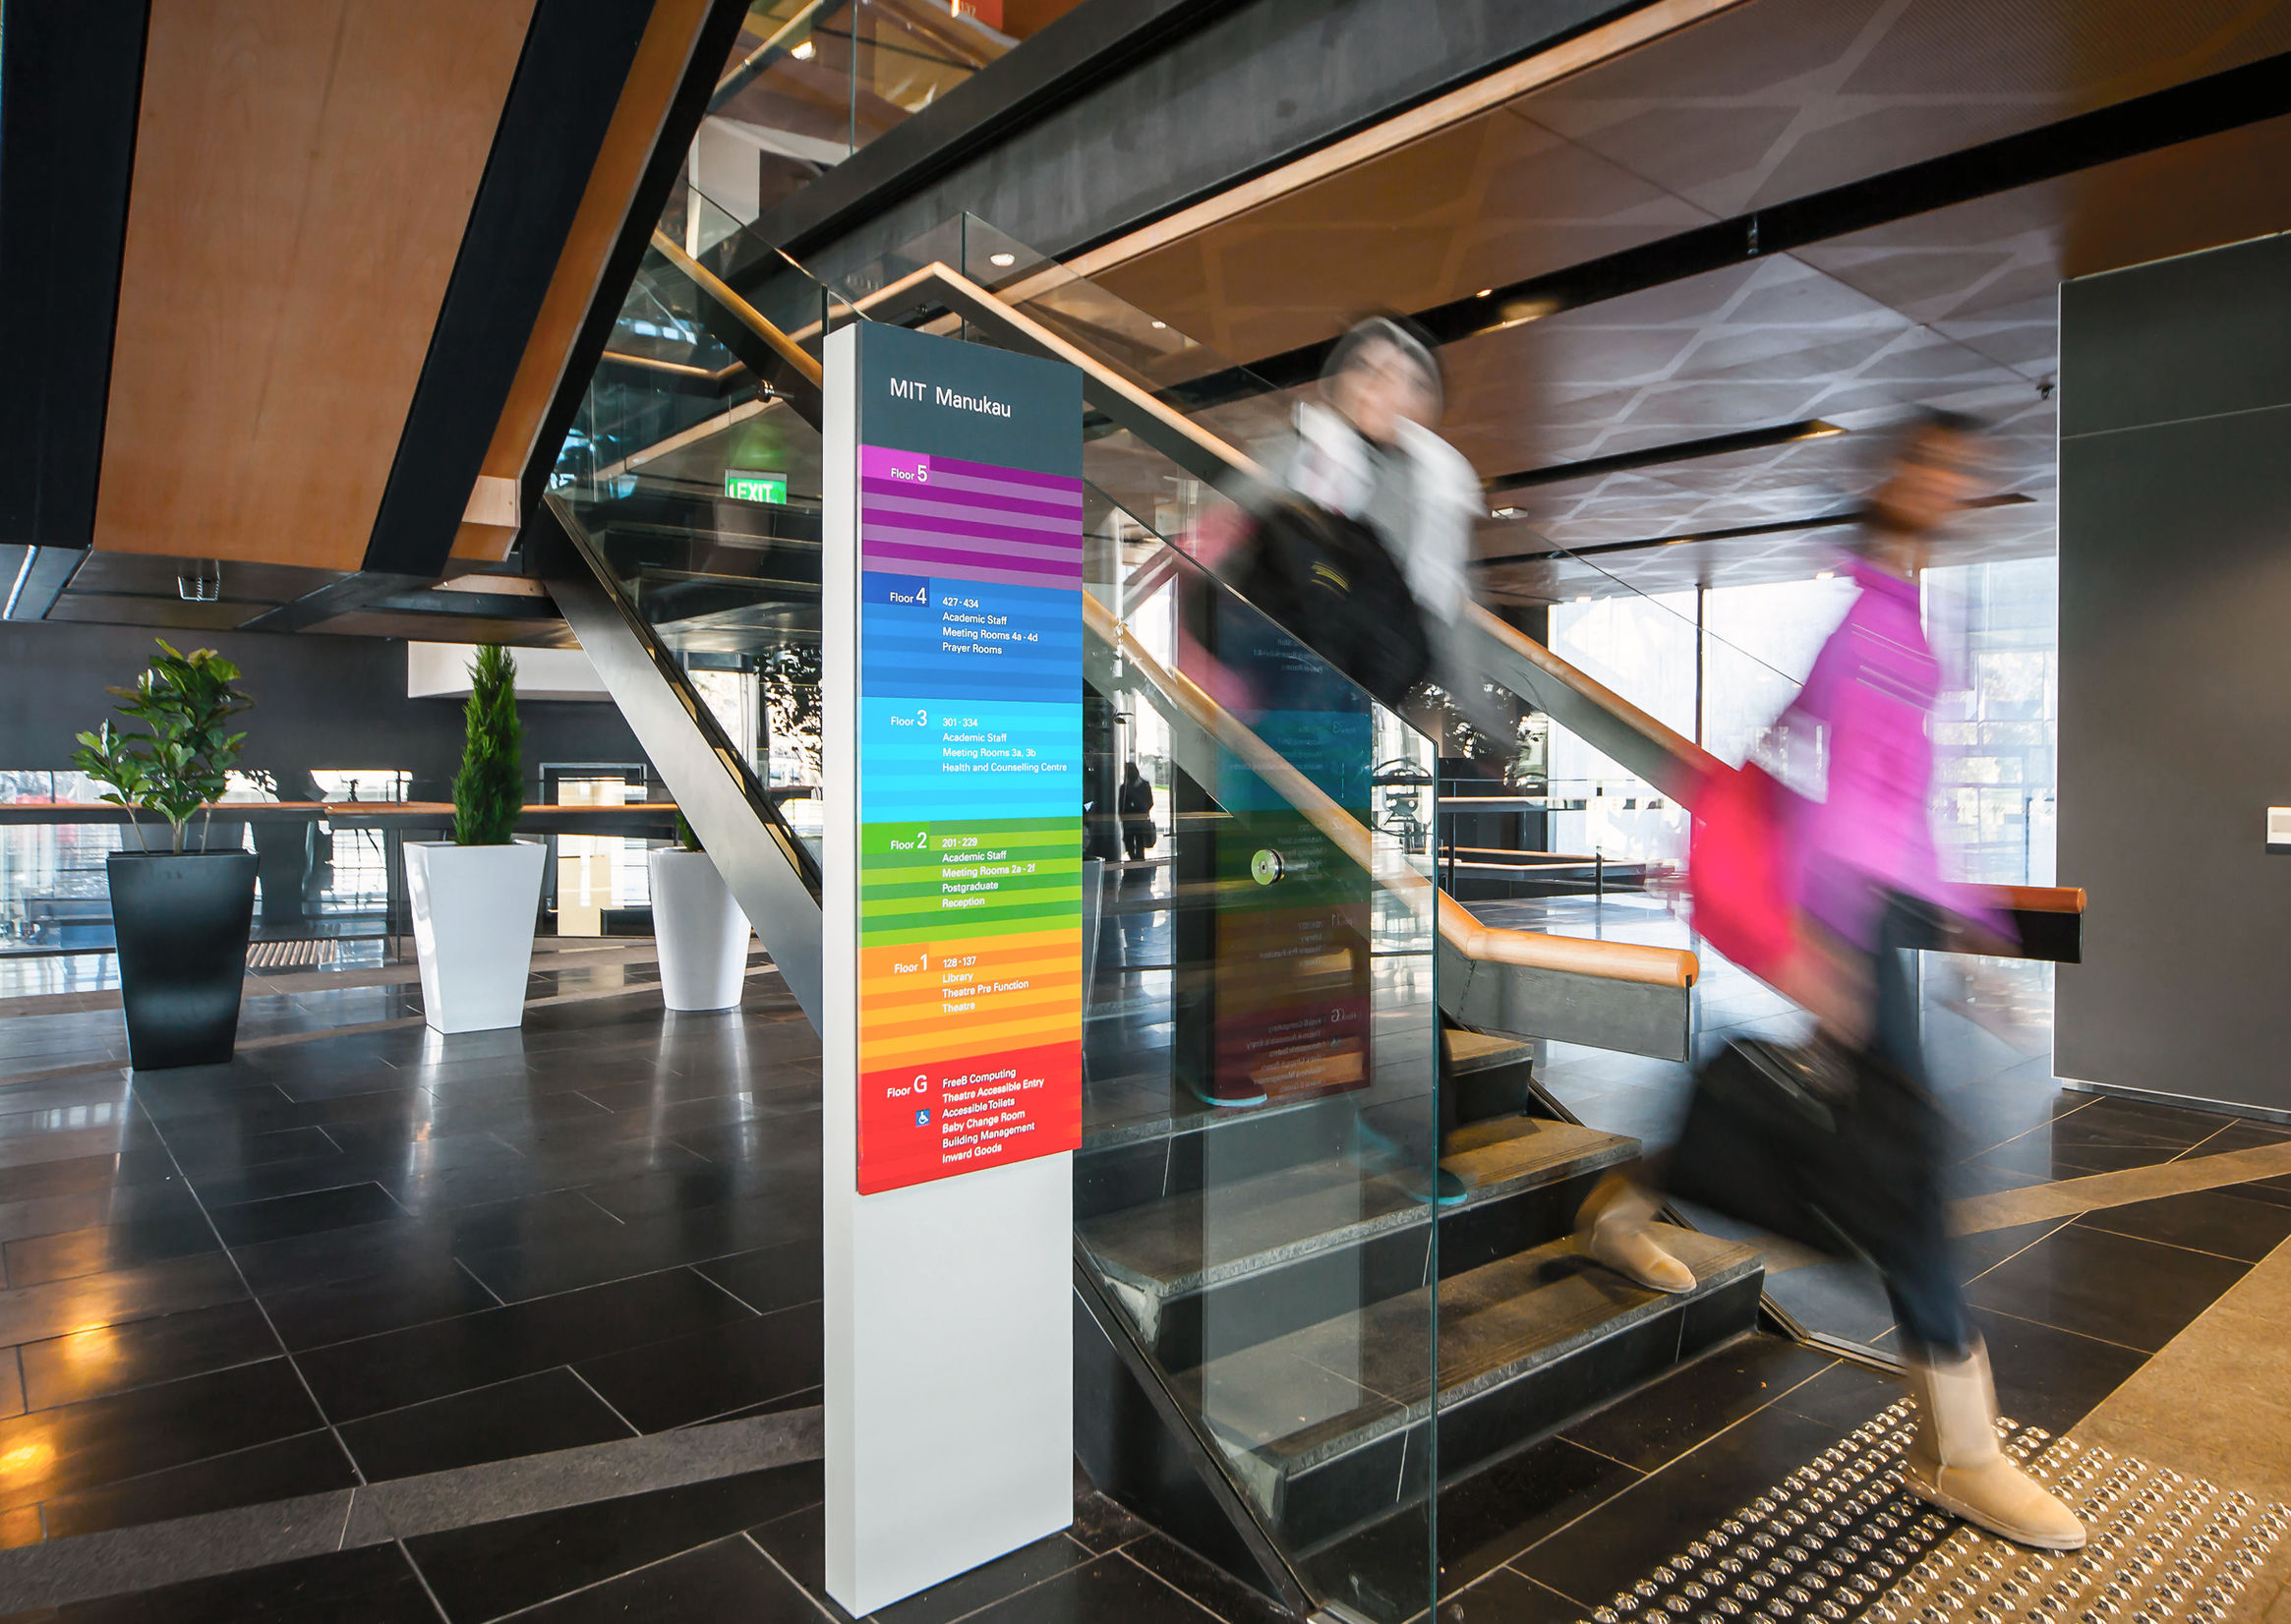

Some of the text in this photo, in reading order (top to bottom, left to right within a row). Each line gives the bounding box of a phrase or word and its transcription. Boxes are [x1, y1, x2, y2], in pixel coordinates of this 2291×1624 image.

[890, 377, 1011, 418] MIT Manukau
[891, 464, 927, 482] Floor 5
[737, 482, 773, 503] EXIT
[890, 587, 927, 605] Floor 4
[942, 611, 1008, 625] Academic Staff
[942, 626, 978, 639] Meeting
[980, 629, 1010, 641] Rooms
[1012, 632, 1022, 641] 4a
[1028, 633, 1038, 642] 4d
[942, 642, 1003, 655] Prayer Rooms
[890, 710, 927, 726] Floor 3
[942, 733, 1007, 742] Academic Staff
[942, 747, 1036, 758] Meeting Rooms 3a, 3b
[942, 762, 1067, 773] Health and Counselling Centre
[890, 832, 927, 850] Floor 2
[942, 850, 1008, 863] Academic Staff
[942, 867, 978, 879] Meeting
[980, 866, 1010, 876] Rooms
[1011, 864, 1021, 874] 2a
[1028, 863, 1035, 873] 2f
[942, 881, 999, 894] Postgraduate
[942, 897, 985, 908] Reception
[894, 954, 927, 973] Floor 1
[942, 972, 973, 984] Library
[942, 980, 1028, 999] Theatre Pre Function
[942, 1002, 975, 1014] Theatre
[887, 1074, 927, 1098] Floor G
[942, 1068, 1017, 1089] FreeB Computing
[942, 1077, 1044, 1104] Theatre Accessible Entry
[942, 1097, 1015, 1119] Accessible Toilets
[942, 1110, 1026, 1134] Baby Change Room
[942, 1122, 1035, 1149] Building Management
[942, 1142, 1002, 1164] Inward Goods
